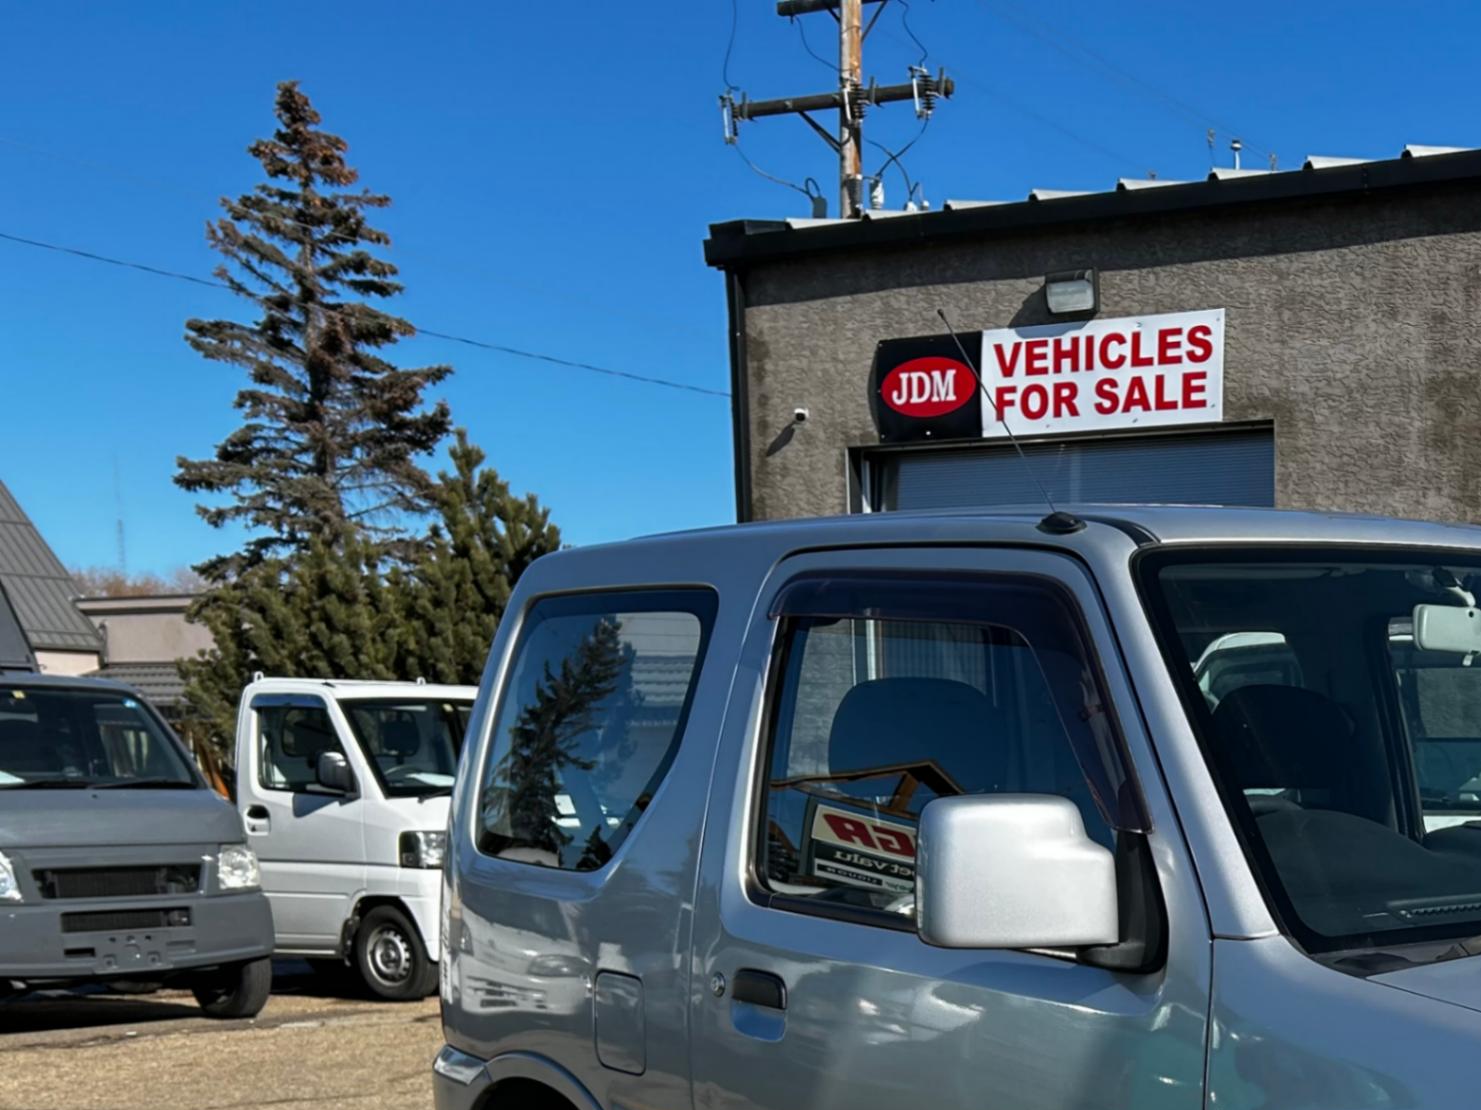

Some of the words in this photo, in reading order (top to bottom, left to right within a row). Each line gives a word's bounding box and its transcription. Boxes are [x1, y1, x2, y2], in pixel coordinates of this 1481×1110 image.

[993, 325, 1213, 378] VEHICLES
[892, 369, 957, 405] JDM
[993, 381, 1080, 421] FOR
[1094, 371, 1207, 415] SALE
